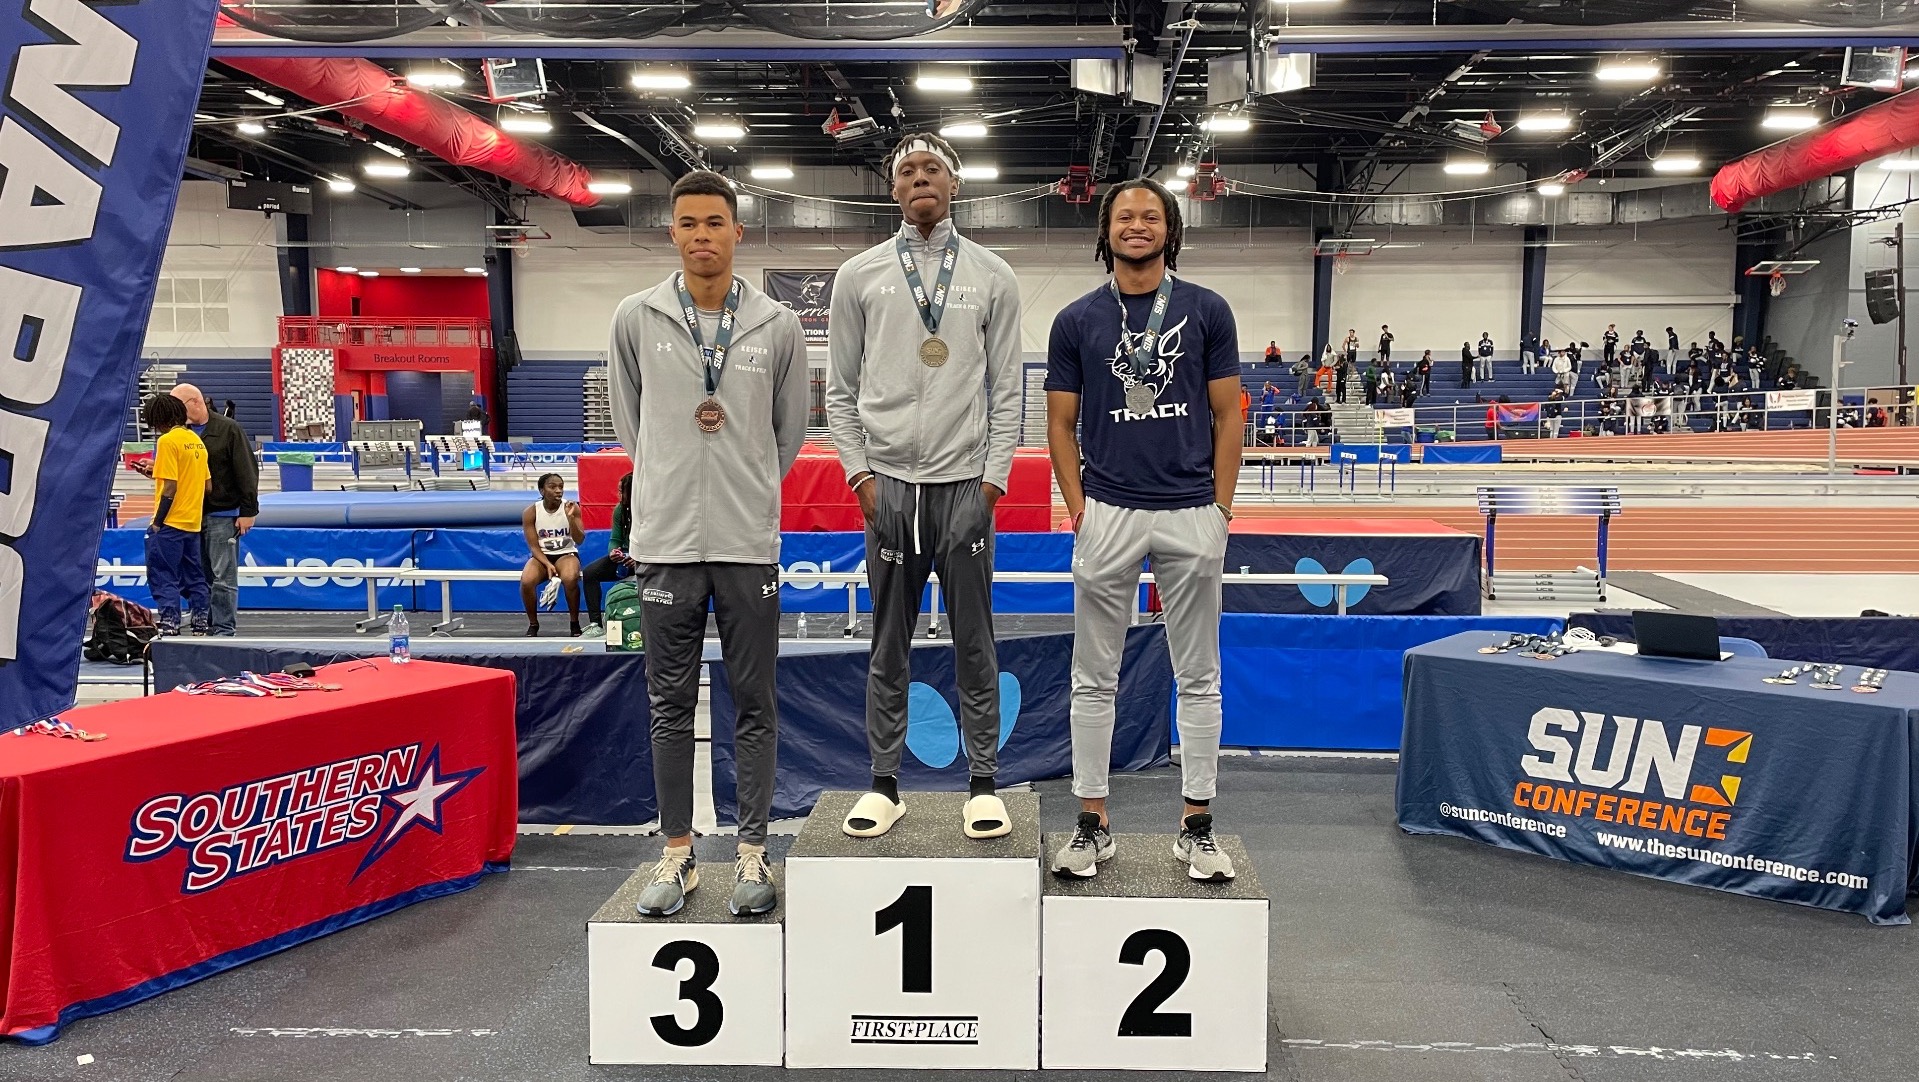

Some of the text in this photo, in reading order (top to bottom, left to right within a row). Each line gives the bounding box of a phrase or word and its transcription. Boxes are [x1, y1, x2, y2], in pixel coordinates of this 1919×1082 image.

[950, 285, 977, 293] KEISER
[374, 353, 450, 364] Breakout Rooms
[740, 345, 768, 355] KEISER
[1109, 403, 1189, 423] TRACK
[547, 528, 571, 538] FMU
[1521, 706, 1702, 800] SUN
[129, 745, 419, 857] SOUTHERN
[1513, 782, 1732, 841] CONFERENCE
[186, 795, 382, 891] STATES
[1440, 802, 1869, 890] @sunconference www.thesunconference.com
[874, 885, 933, 994] 1
[649, 939, 724, 1047] 3
[1117, 928, 1193, 1038] 2
[850, 1021, 979, 1039] FIRST PLACE
